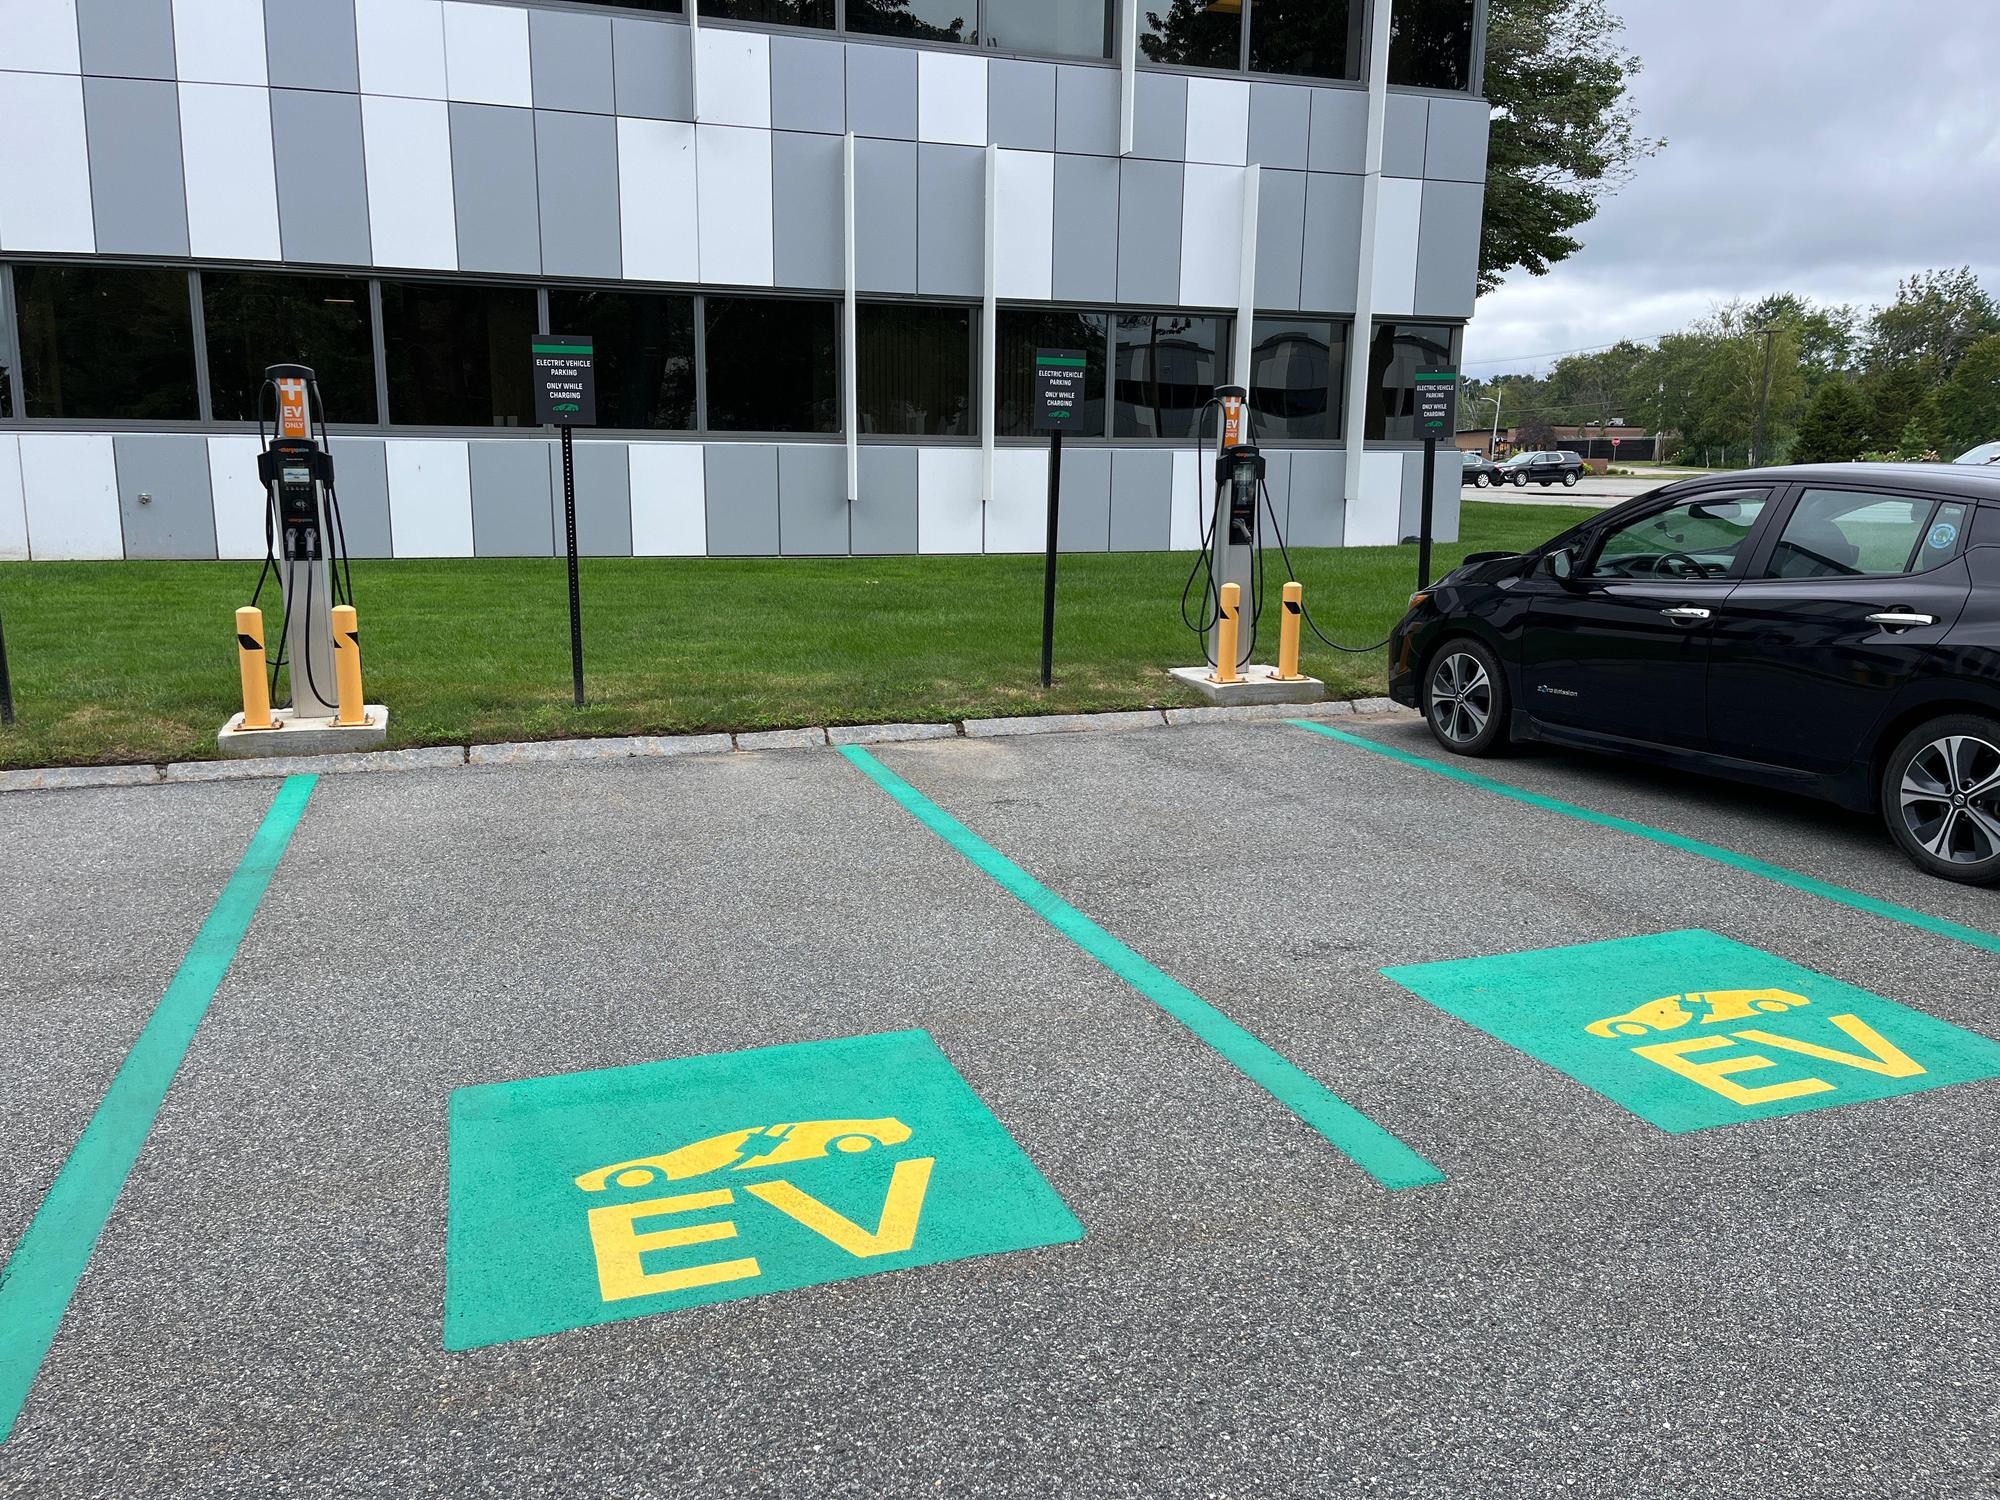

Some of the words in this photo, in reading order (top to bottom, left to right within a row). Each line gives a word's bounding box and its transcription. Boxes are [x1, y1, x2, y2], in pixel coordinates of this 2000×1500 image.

[536, 359, 565, 367] ELECTRIC
[1063, 371, 1084, 379] VEHICLE
[546, 382, 562, 390] ONLY
[563, 382, 583, 390] WHILE
[549, 391, 581, 399] CHARGING
[283, 405, 302, 417] EV
[1226, 419, 1238, 429] EV
[1631, 1013, 1928, 1106] EV
[587, 1156, 935, 1302] EV
